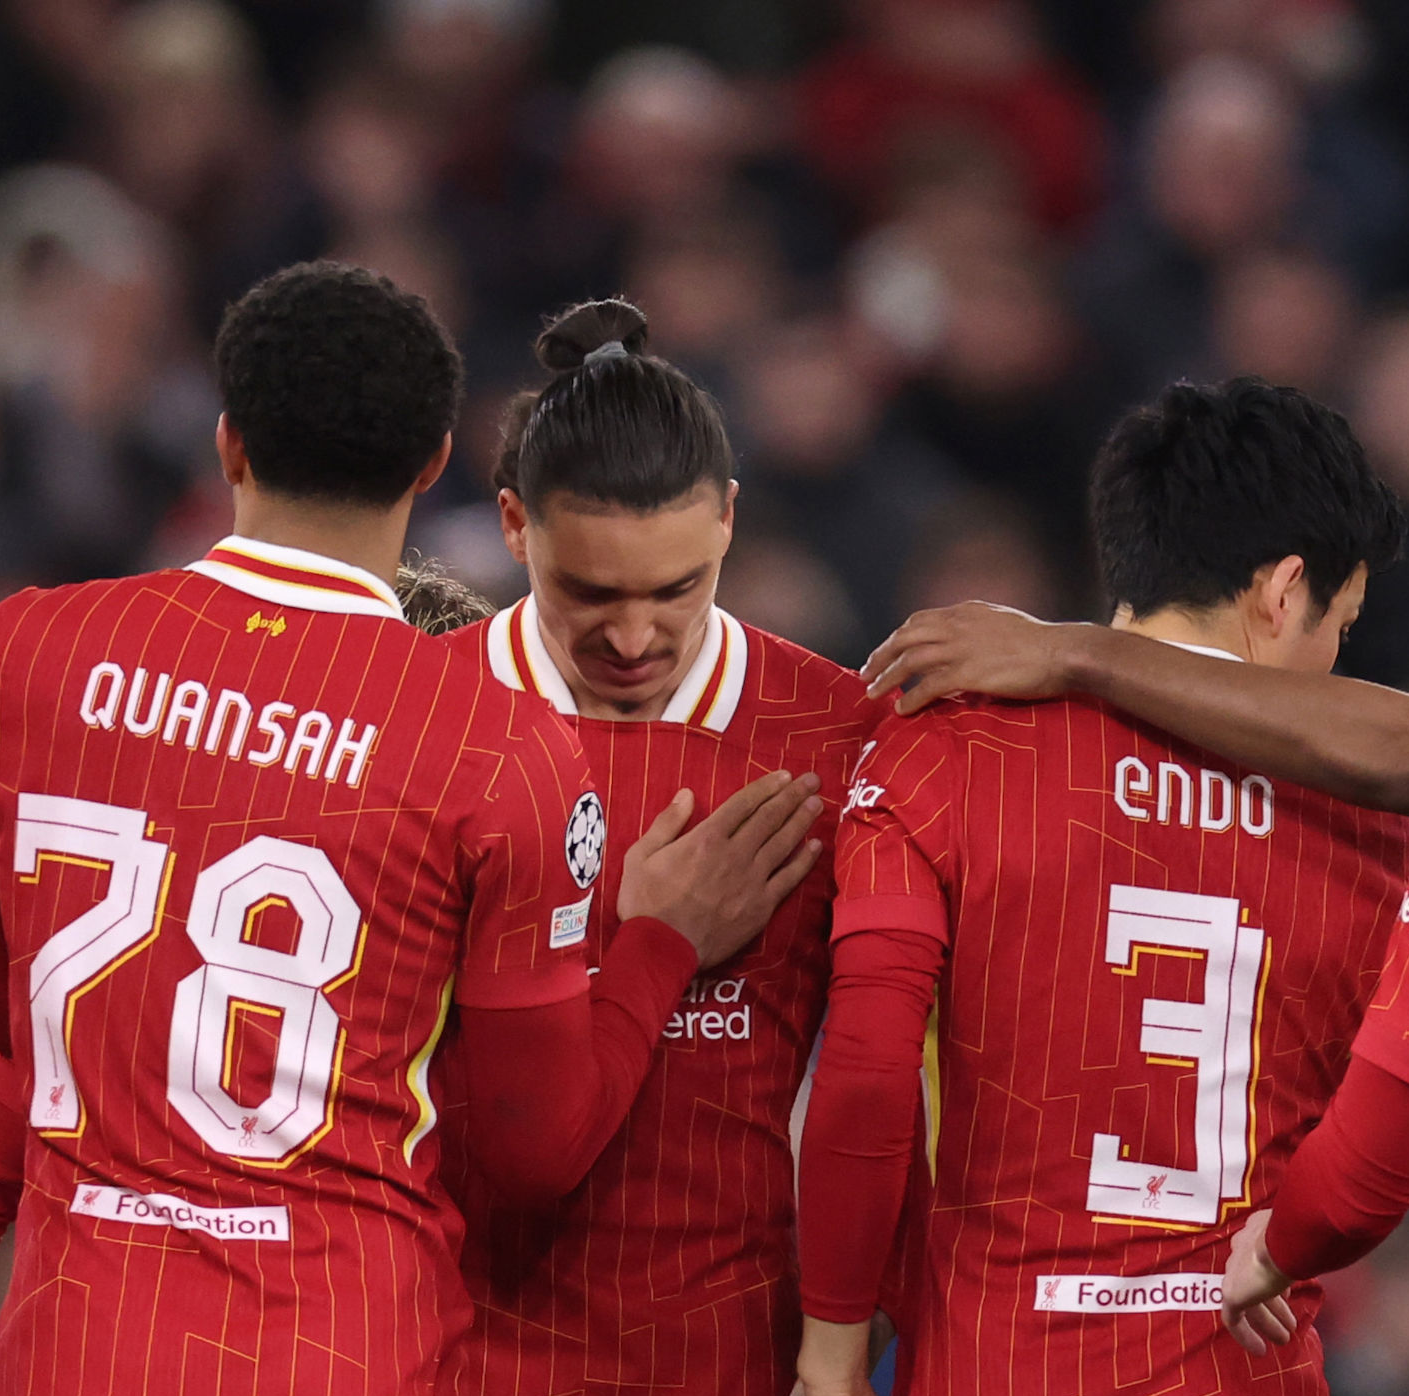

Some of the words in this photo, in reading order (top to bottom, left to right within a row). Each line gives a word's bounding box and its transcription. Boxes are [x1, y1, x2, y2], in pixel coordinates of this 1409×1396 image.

[79, 660, 378, 789] QUANSAH
[1114, 755, 1274, 839] ENDO
[13, 792, 369, 1169] 78
[1086, 884, 1272, 1233] 3
[1078, 1280, 1223, 1307] Foundatio
